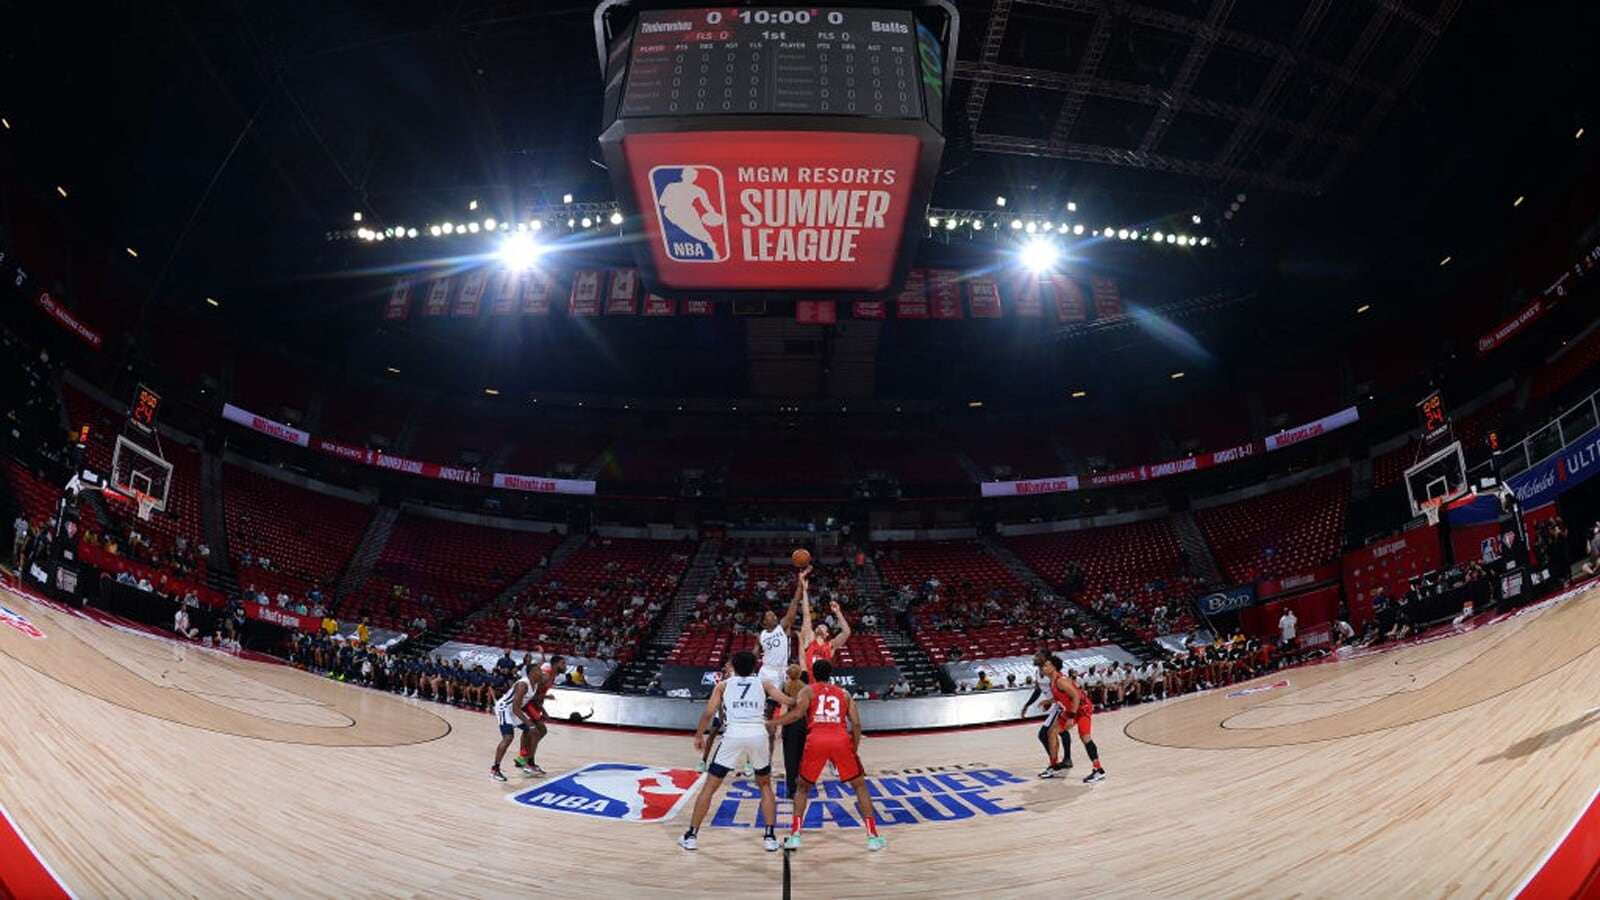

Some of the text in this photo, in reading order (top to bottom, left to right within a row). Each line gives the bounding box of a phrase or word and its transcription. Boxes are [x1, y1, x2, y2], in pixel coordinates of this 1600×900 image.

[706, 11, 722, 24] 0
[739, 10, 810, 24] 10:00
[827, 11, 843, 24] 0
[871, 21, 908, 33] Bulls
[762, 31, 786, 40] 1st
[738, 167, 896, 185] MGM RESORTS
[740, 188, 890, 228] SUMMER
[673, 242, 705, 256] NBA
[743, 228, 860, 262] LEAGUE
[765, 638, 781, 650] 30
[737, 683, 752, 700] 7
[815, 695, 840, 717] 13
[530, 791, 611, 812] NBA
[711, 790, 1025, 828] LEAGUE
